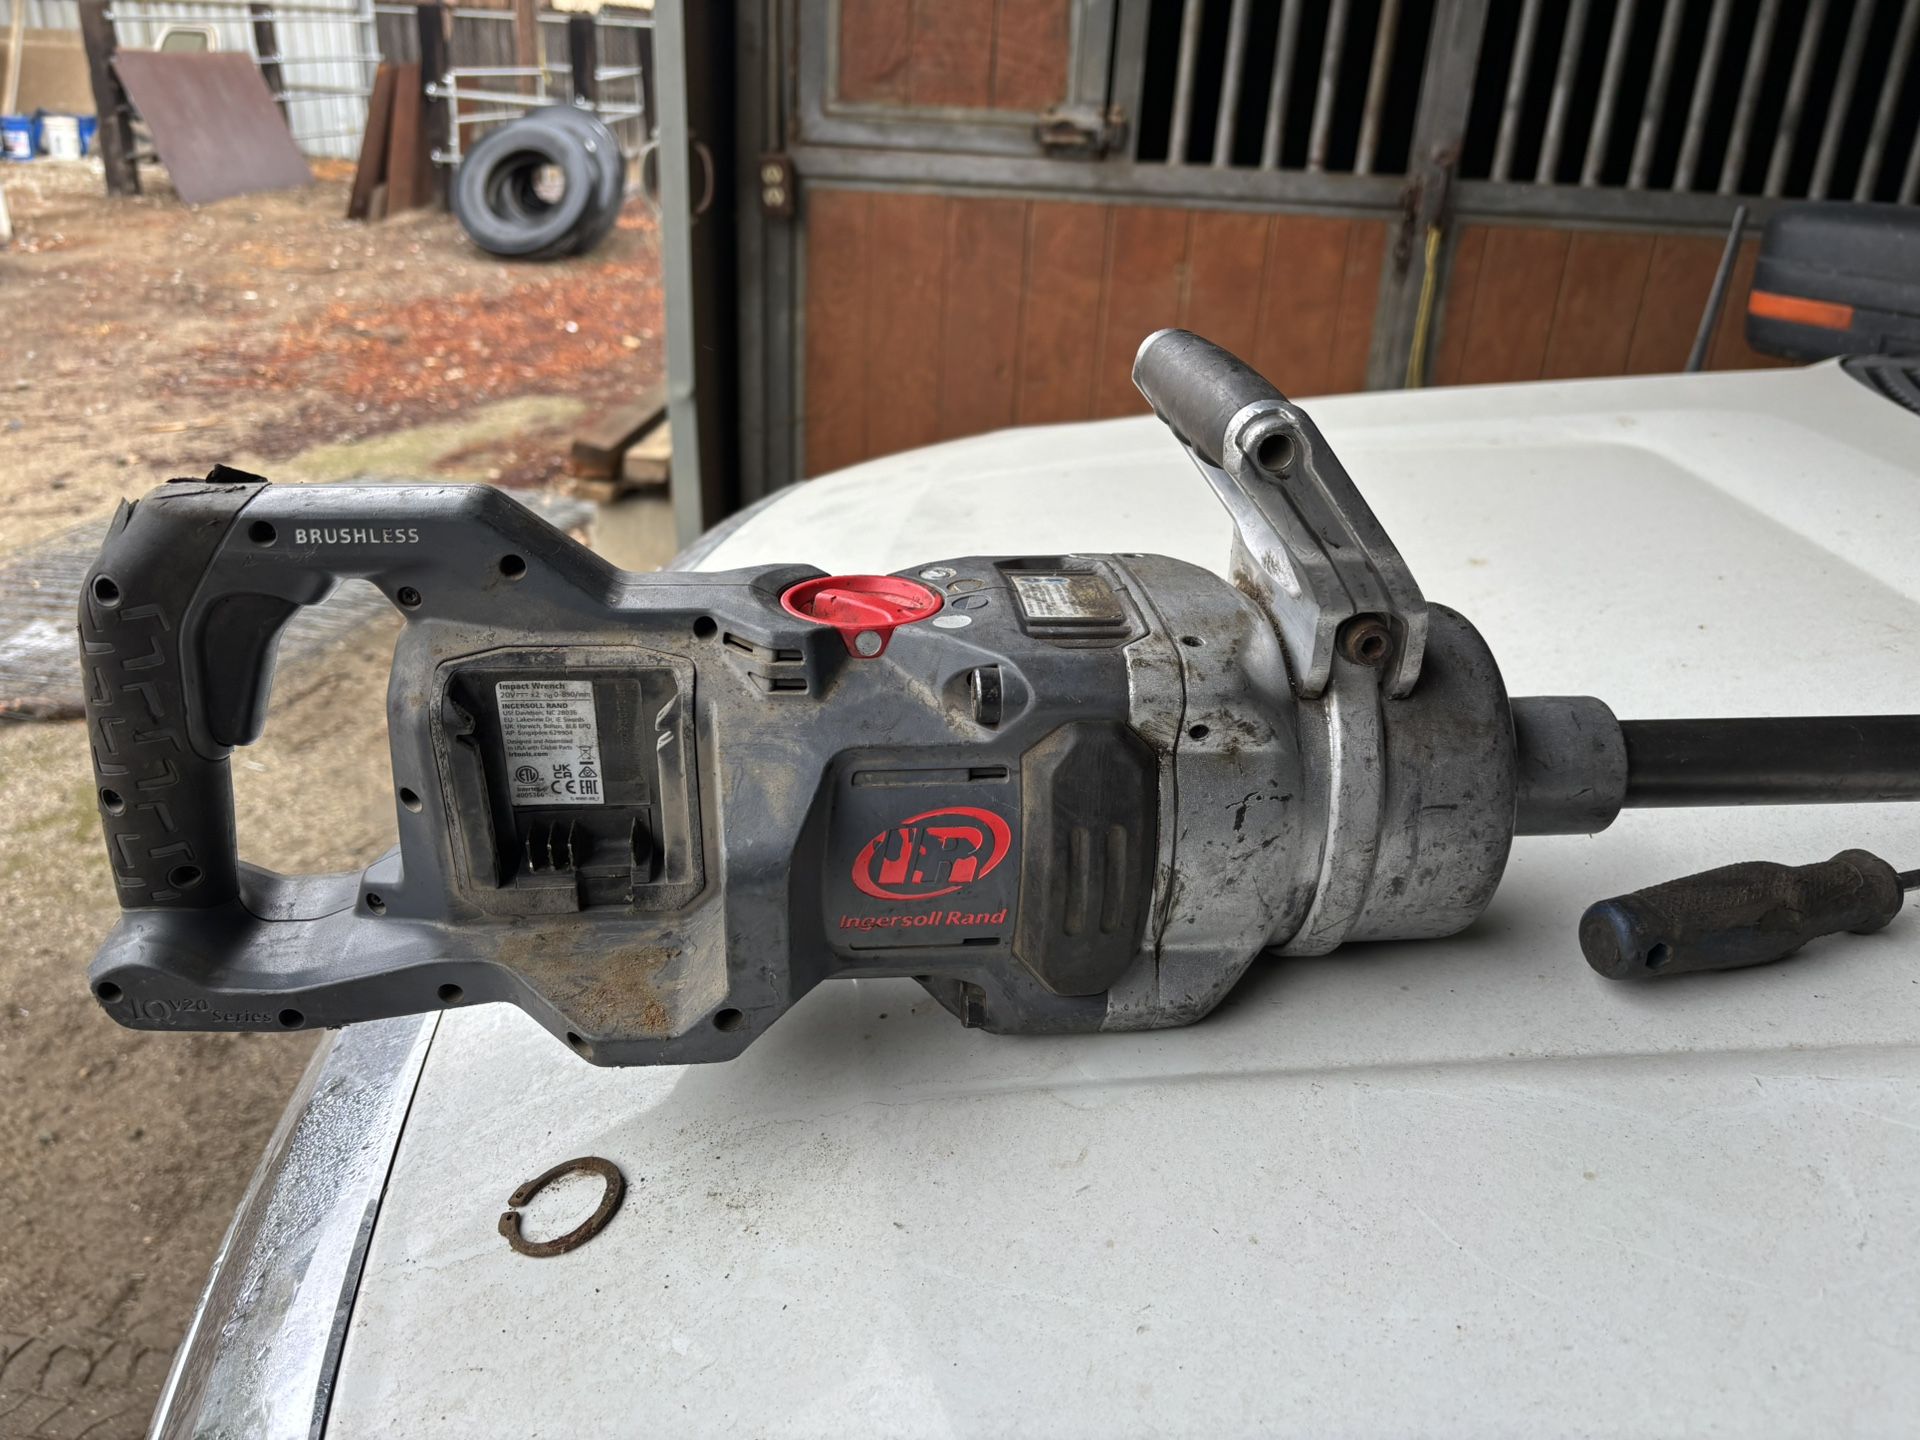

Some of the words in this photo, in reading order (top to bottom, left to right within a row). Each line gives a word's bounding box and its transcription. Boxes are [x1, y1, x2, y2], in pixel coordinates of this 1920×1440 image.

[295, 528, 420, 544] BRUSHLESS
[499, 683, 530, 691] Impact
[553, 764, 571, 772] UK
[551, 780, 576, 794] CE
[840, 912, 942, 932] Ingersoll
[946, 909, 1007, 926] Rand
[211, 1008, 273, 1024] Series
